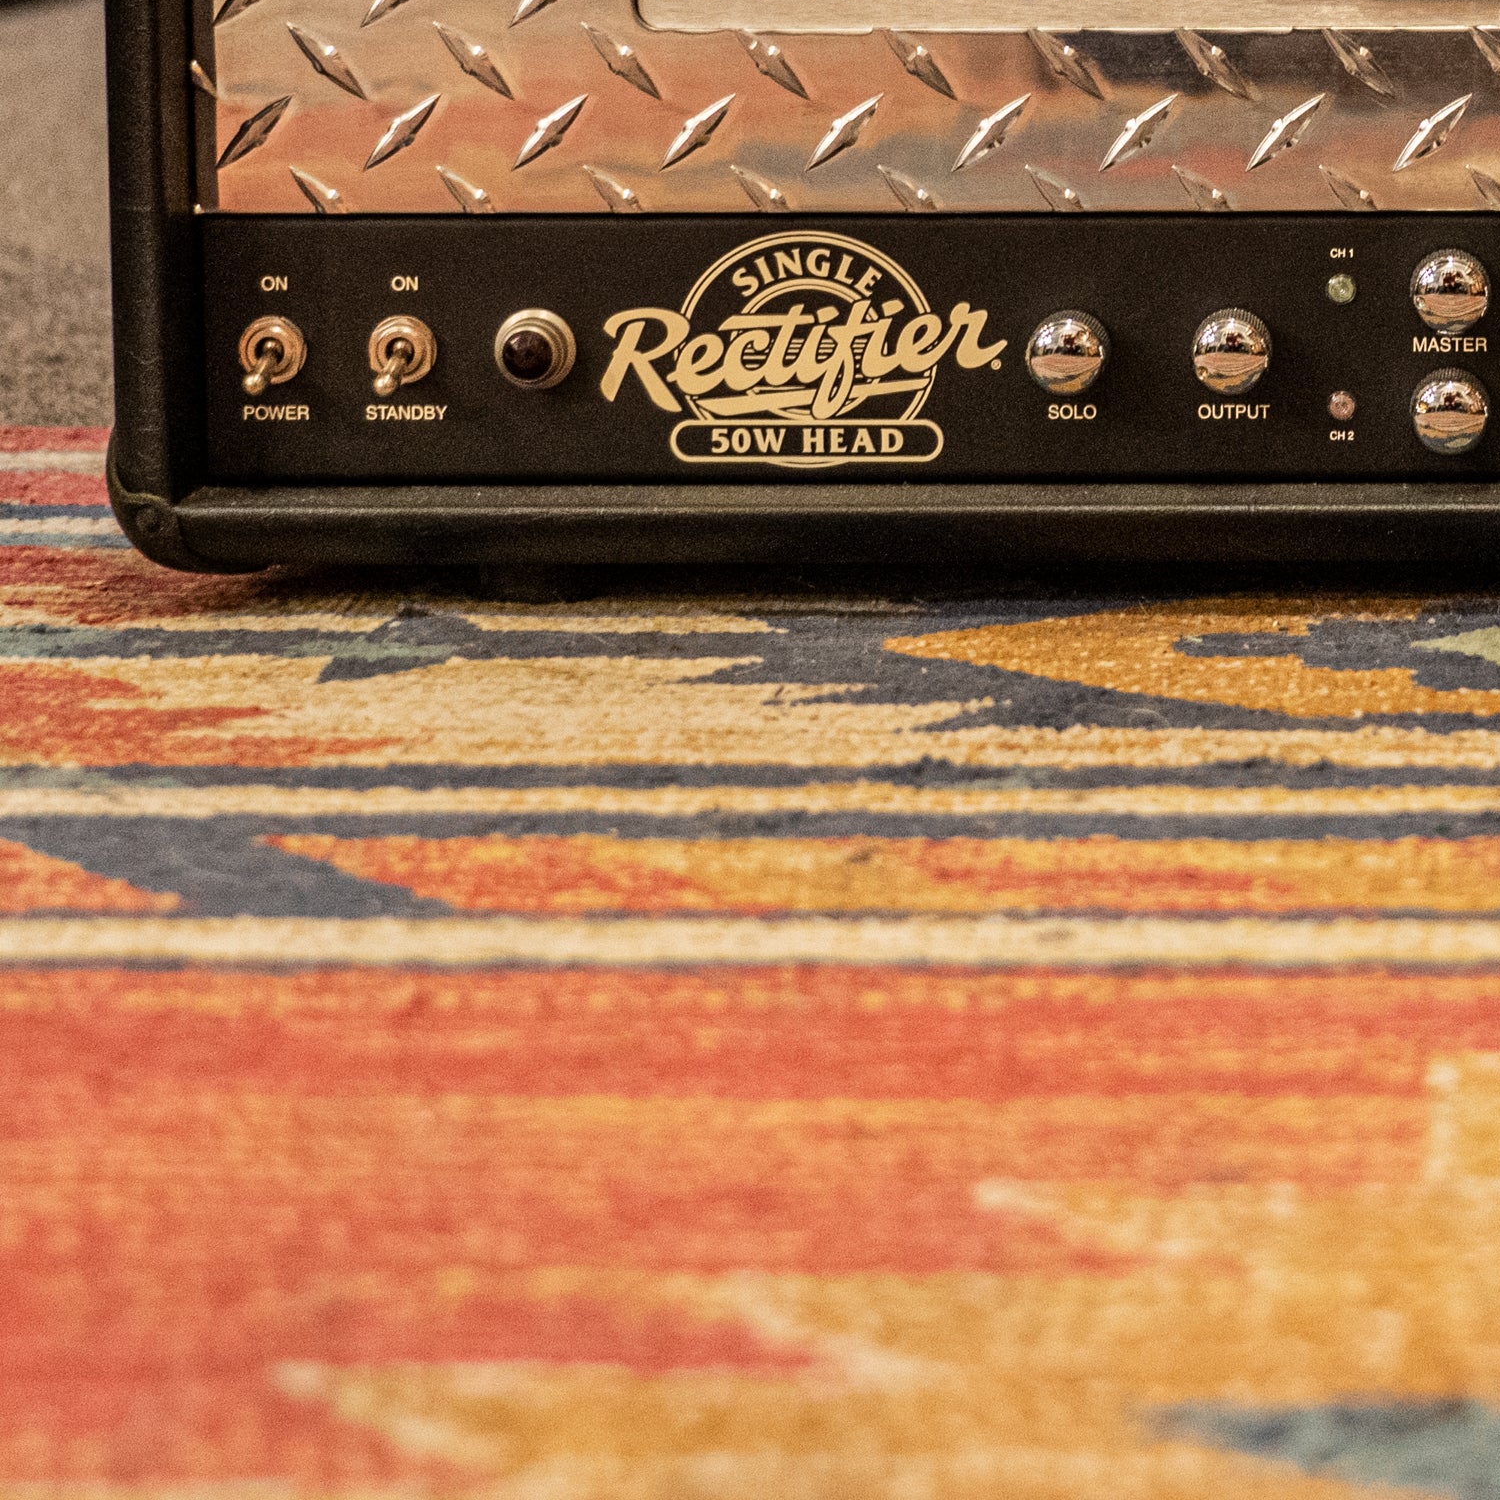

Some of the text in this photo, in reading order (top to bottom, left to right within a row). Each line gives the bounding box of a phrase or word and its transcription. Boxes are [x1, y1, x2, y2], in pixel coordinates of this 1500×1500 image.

[1329, 247, 1346, 259] CH
[731, 247, 883, 298] SINGLE
[260, 275, 288, 292] ON
[390, 275, 419, 292] ON
[1412, 337, 1488, 353] MASTER
[600, 299, 1008, 419] Rectifier
[243, 404, 310, 421] POWER
[365, 404, 448, 421] STANDBY
[1047, 404, 1097, 420] SOLO
[1197, 403, 1271, 420] OUTPUT
[710, 428, 904, 454] 50W HEAD
[1329, 430, 1355, 441] CH 2
